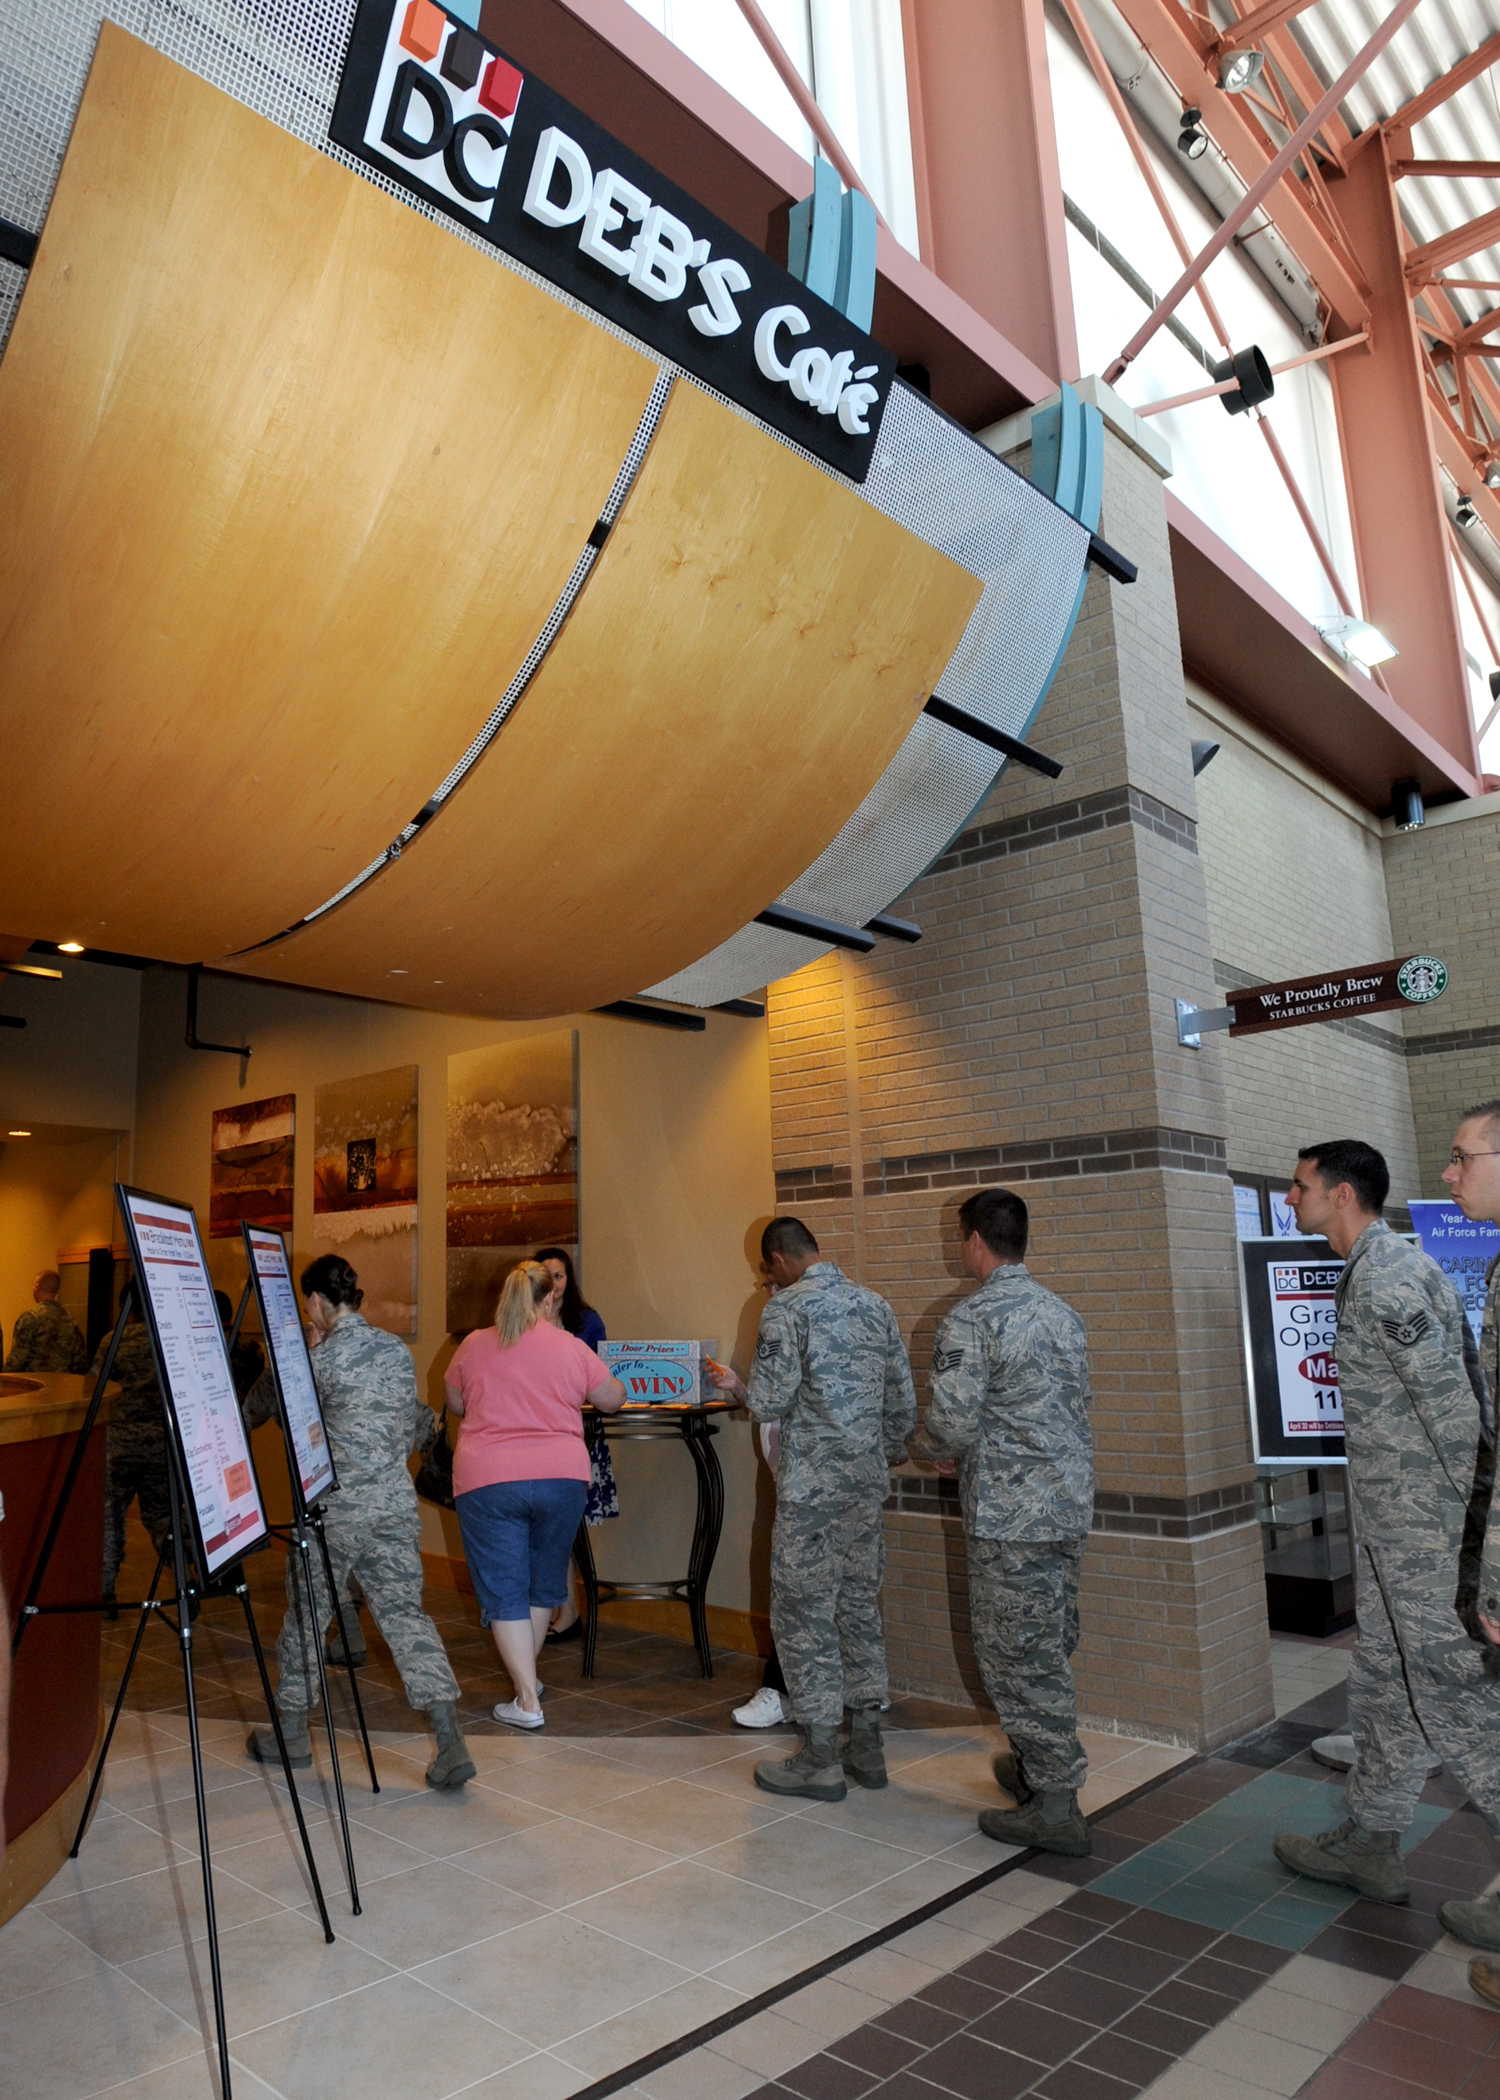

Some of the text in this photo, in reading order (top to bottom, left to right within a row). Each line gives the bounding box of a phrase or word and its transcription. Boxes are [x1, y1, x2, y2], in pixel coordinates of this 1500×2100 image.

[381, 59, 510, 203] DC
[522, 126, 879, 435] DEB'S Café
[1400, 957, 1445, 980] STARBUCKS
[1259, 975, 1383, 1008] We Proudly Brew
[1405, 986, 1441, 1000] COFFEE
[1269, 993, 1376, 1020] STARBUCKS COFFEE
[1440, 1213, 1464, 1224] Year
[1431, 1227, 1445, 1237] Air
[1448, 1227, 1476, 1237] Force
[1278, 1277, 1299, 1289] DC
[621, 1344, 674, 1353] Door Prizes
[629, 1376, 684, 1395] WIN!
[1314, 1390, 1343, 1409] 11
[1290, 1422, 1301, 1431] April
